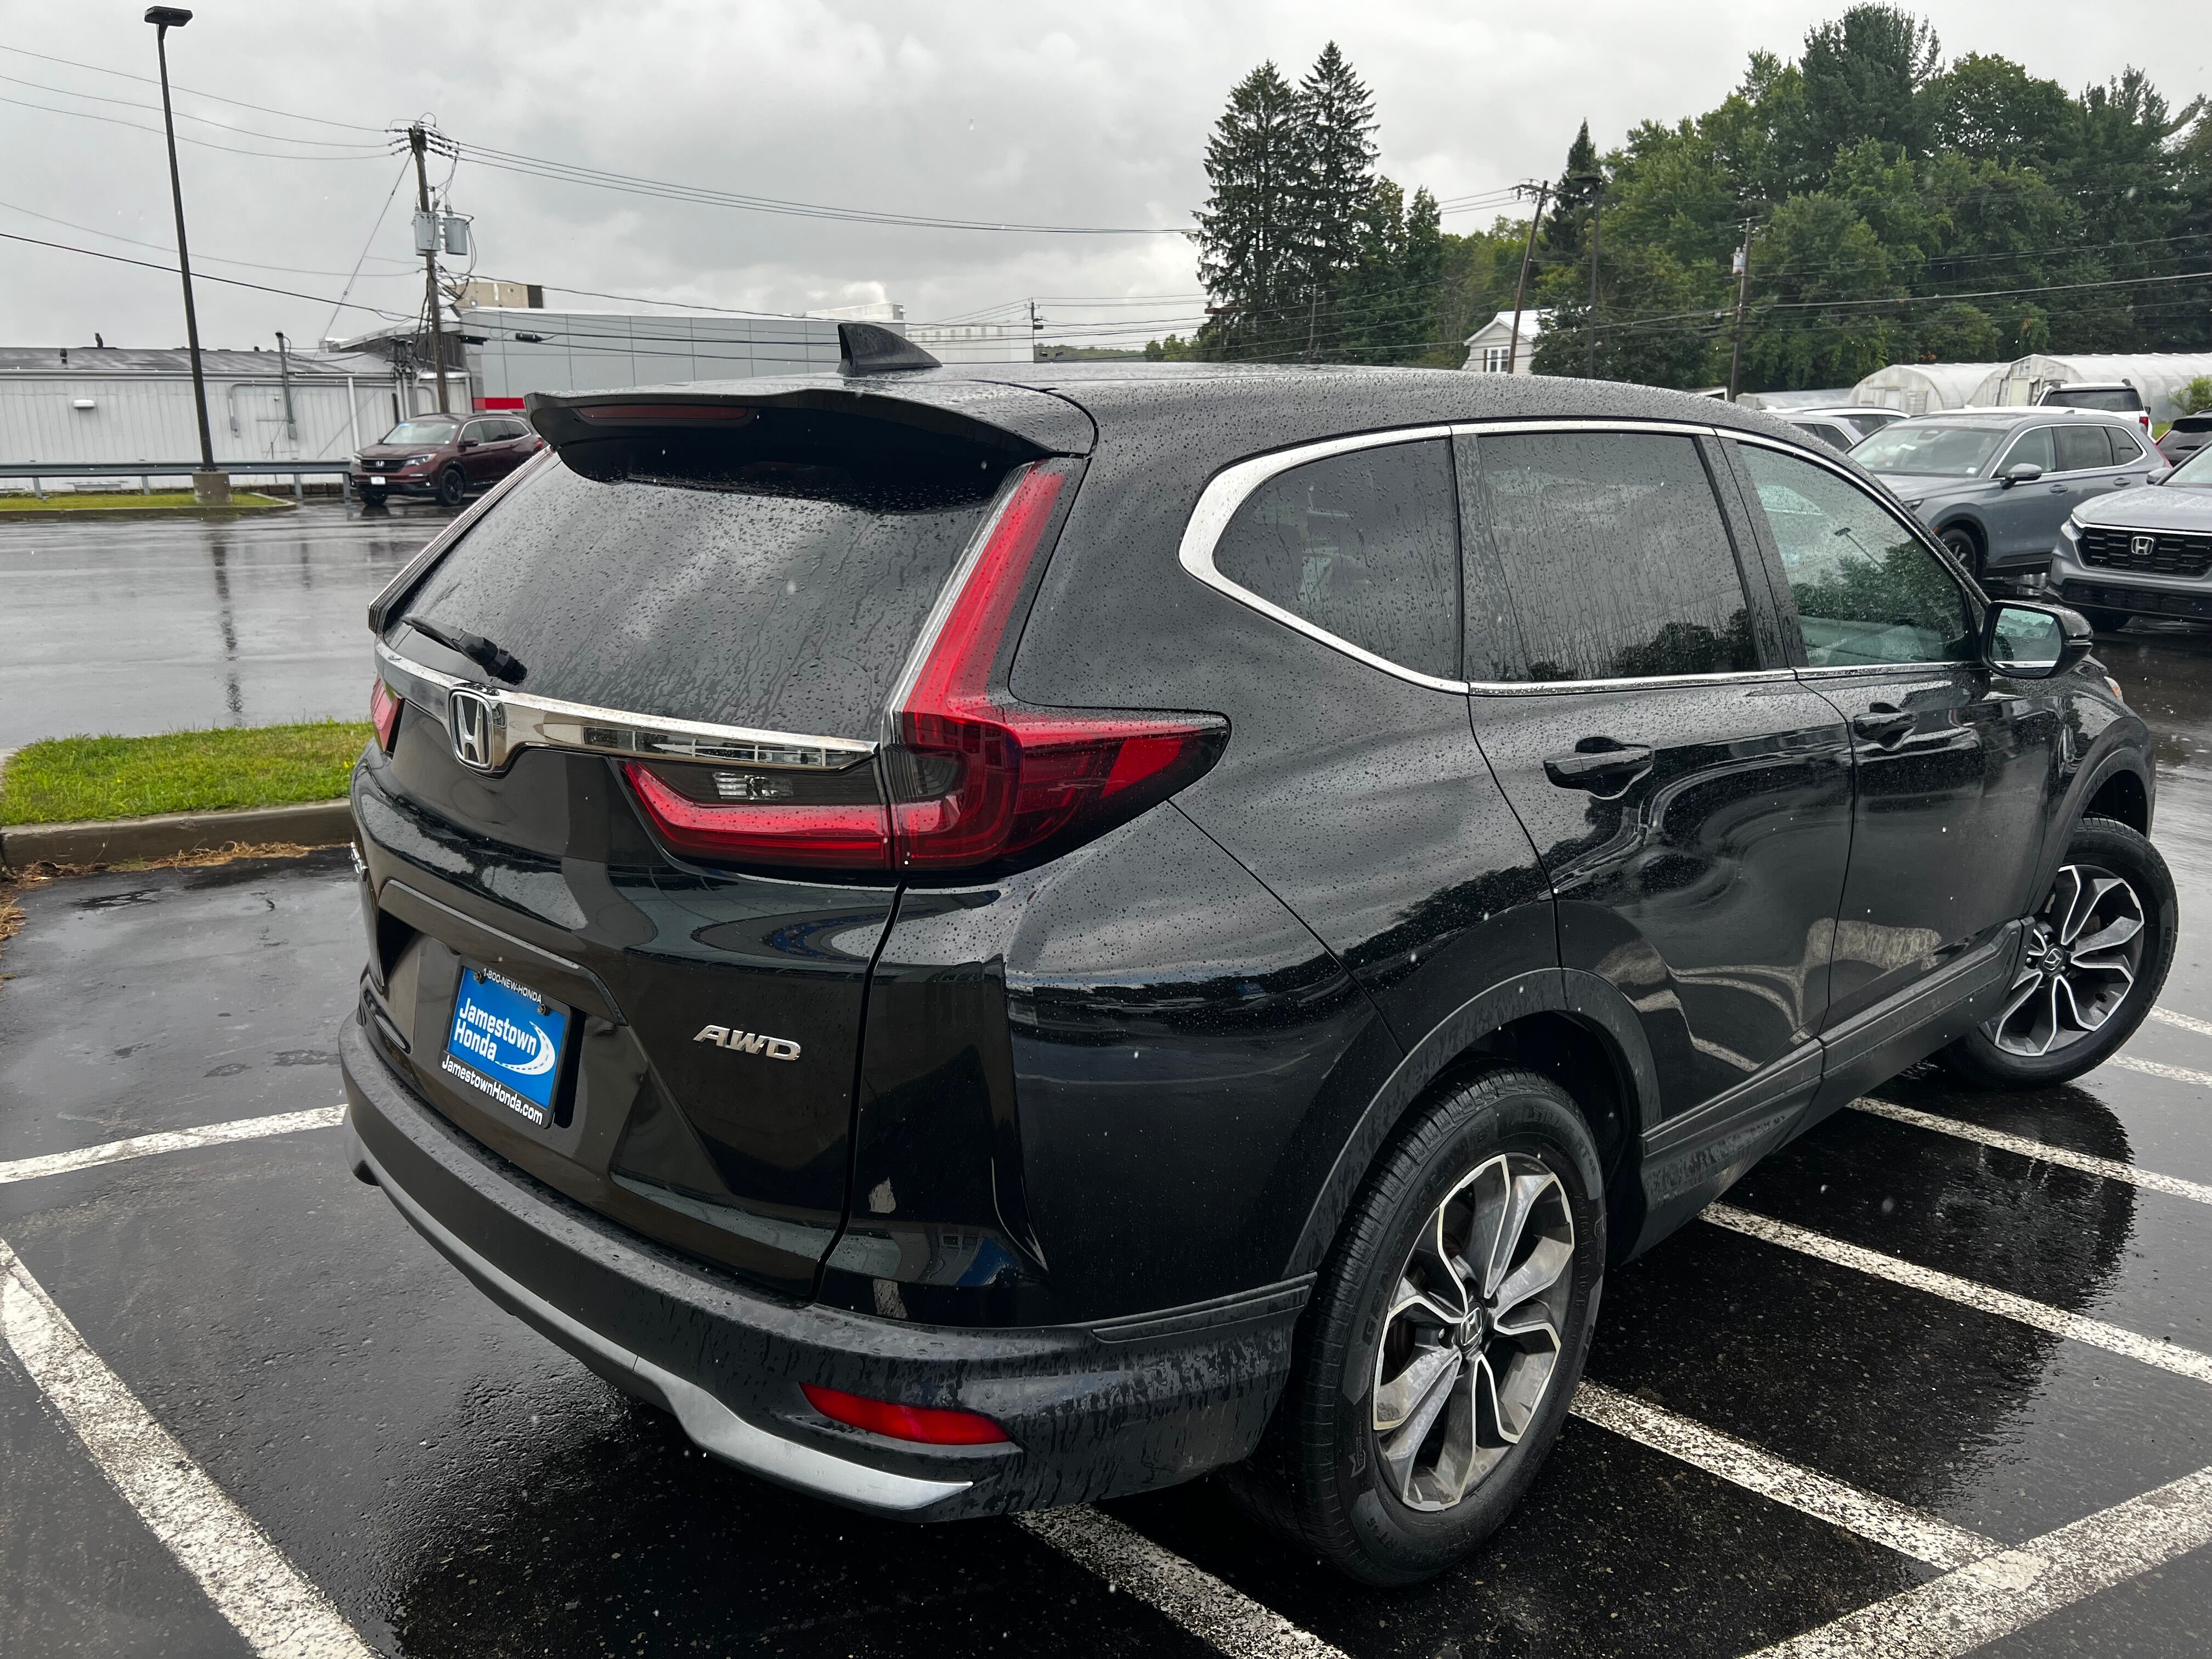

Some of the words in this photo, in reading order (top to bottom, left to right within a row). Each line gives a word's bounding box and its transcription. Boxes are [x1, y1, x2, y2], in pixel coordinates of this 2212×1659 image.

[483, 967, 543, 1005] 1-800-NEW-HONDA
[454, 1018, 498, 1062] Honda
[459, 997, 538, 1056] Jamestown
[692, 1024, 801, 1061] AWD
[442, 1054, 543, 1126] JamestownHonda.com
